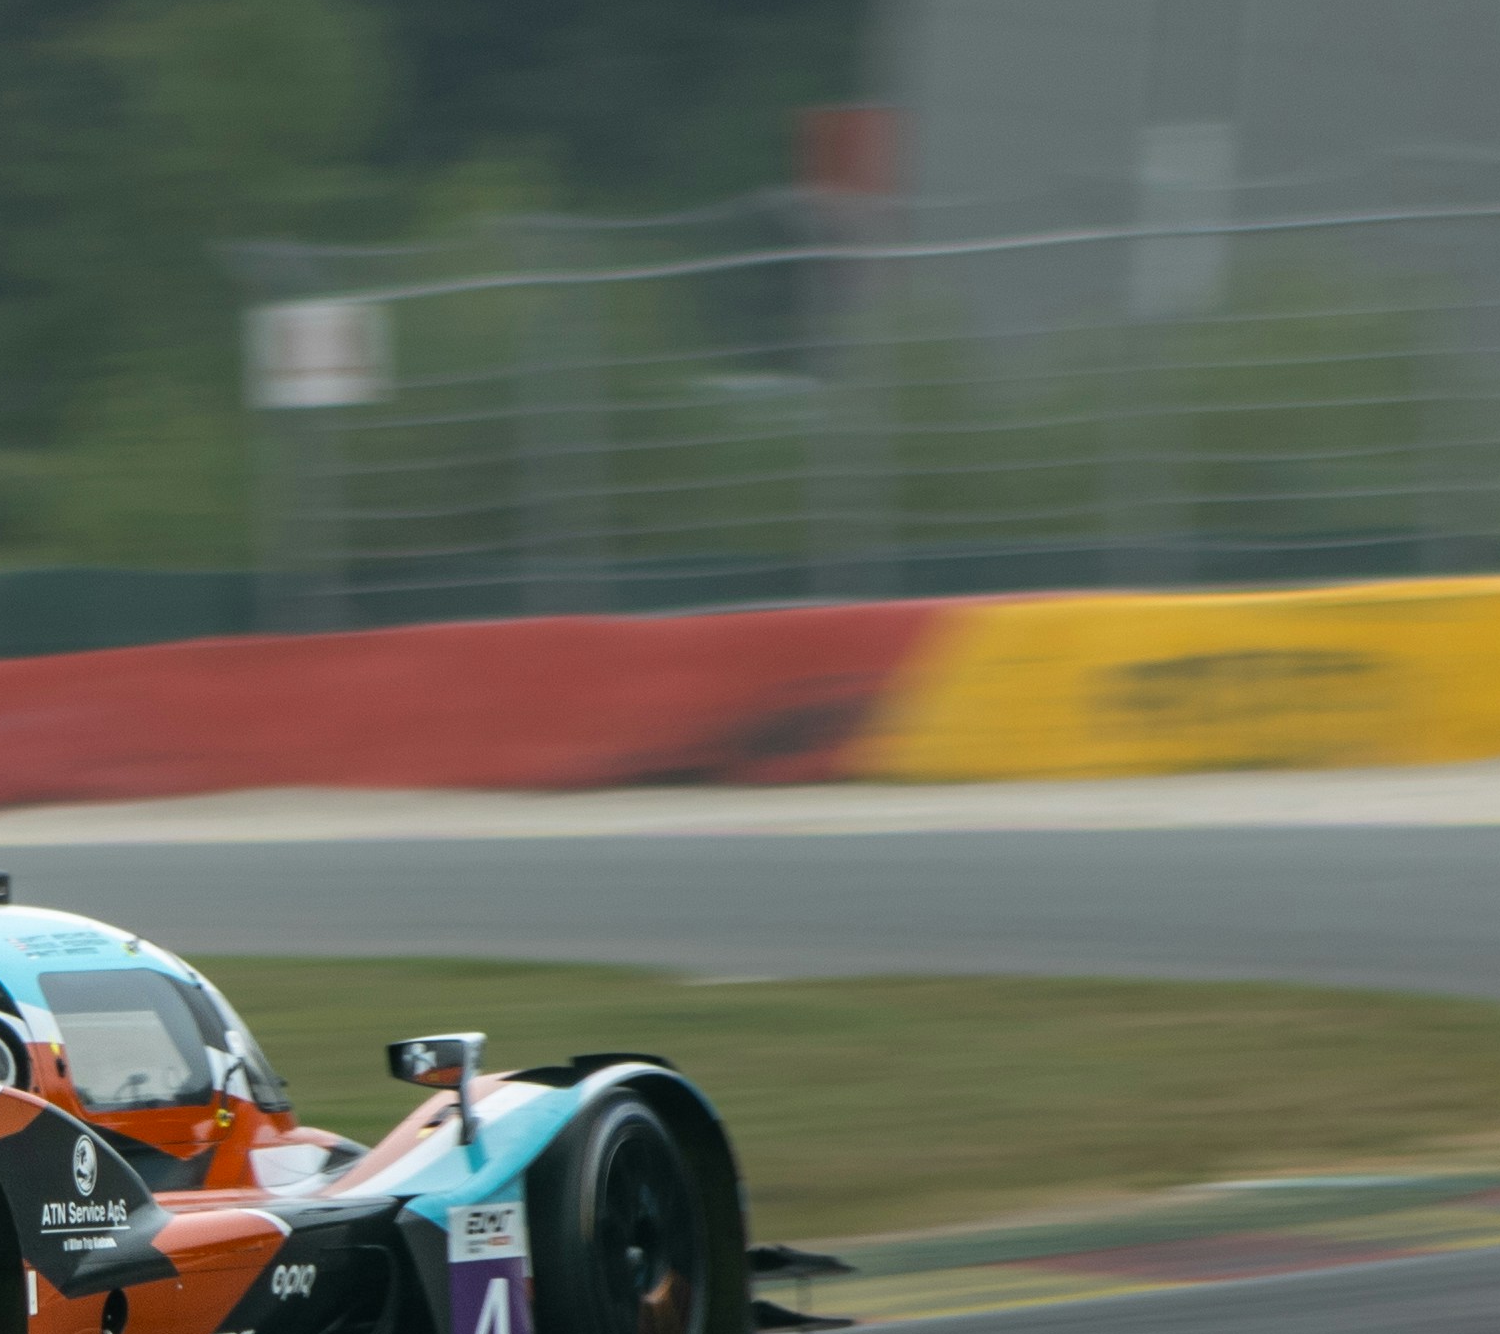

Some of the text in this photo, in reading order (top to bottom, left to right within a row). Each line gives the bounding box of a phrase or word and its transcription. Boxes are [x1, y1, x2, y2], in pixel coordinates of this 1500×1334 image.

[41, 1198, 127, 1226] ATN Service ApS
